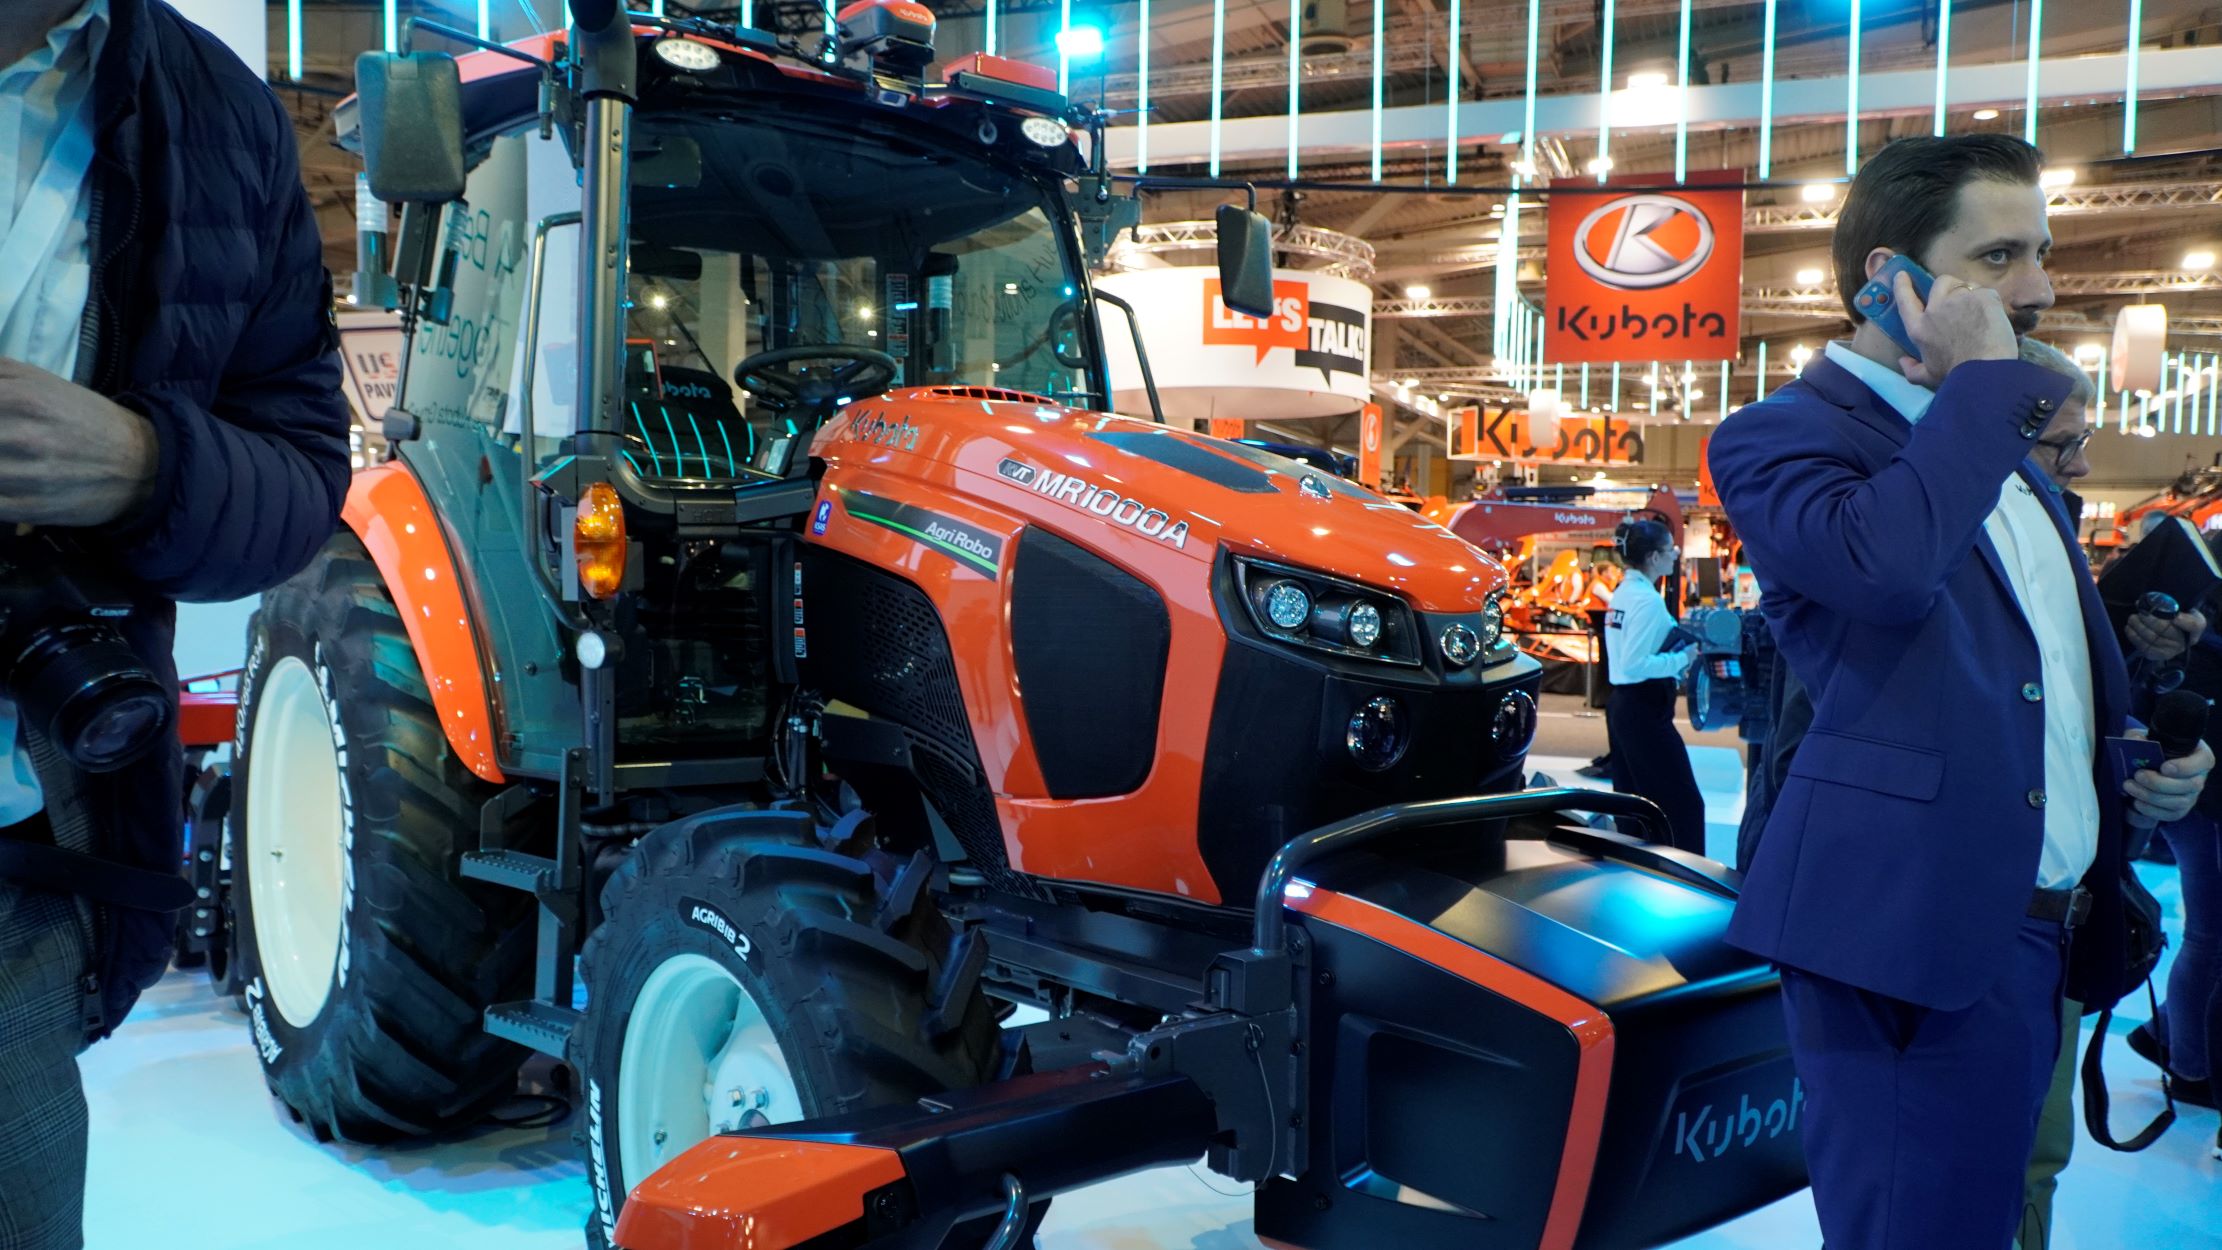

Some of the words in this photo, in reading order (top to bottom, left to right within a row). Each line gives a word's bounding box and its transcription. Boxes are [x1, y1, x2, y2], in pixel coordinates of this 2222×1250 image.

[1307, 317, 1364, 361] TALK!
[1557, 303, 1726, 341] Kubota
[851, 408, 919, 451] Kubota
[1032, 469, 1190, 549] MR1000A
[1554, 512, 1596, 525] Kubota
[691, 905, 737, 944] AGRIBIB
[734, 933, 751, 962] 2
[1674, 1077, 1807, 1163] Kubot
